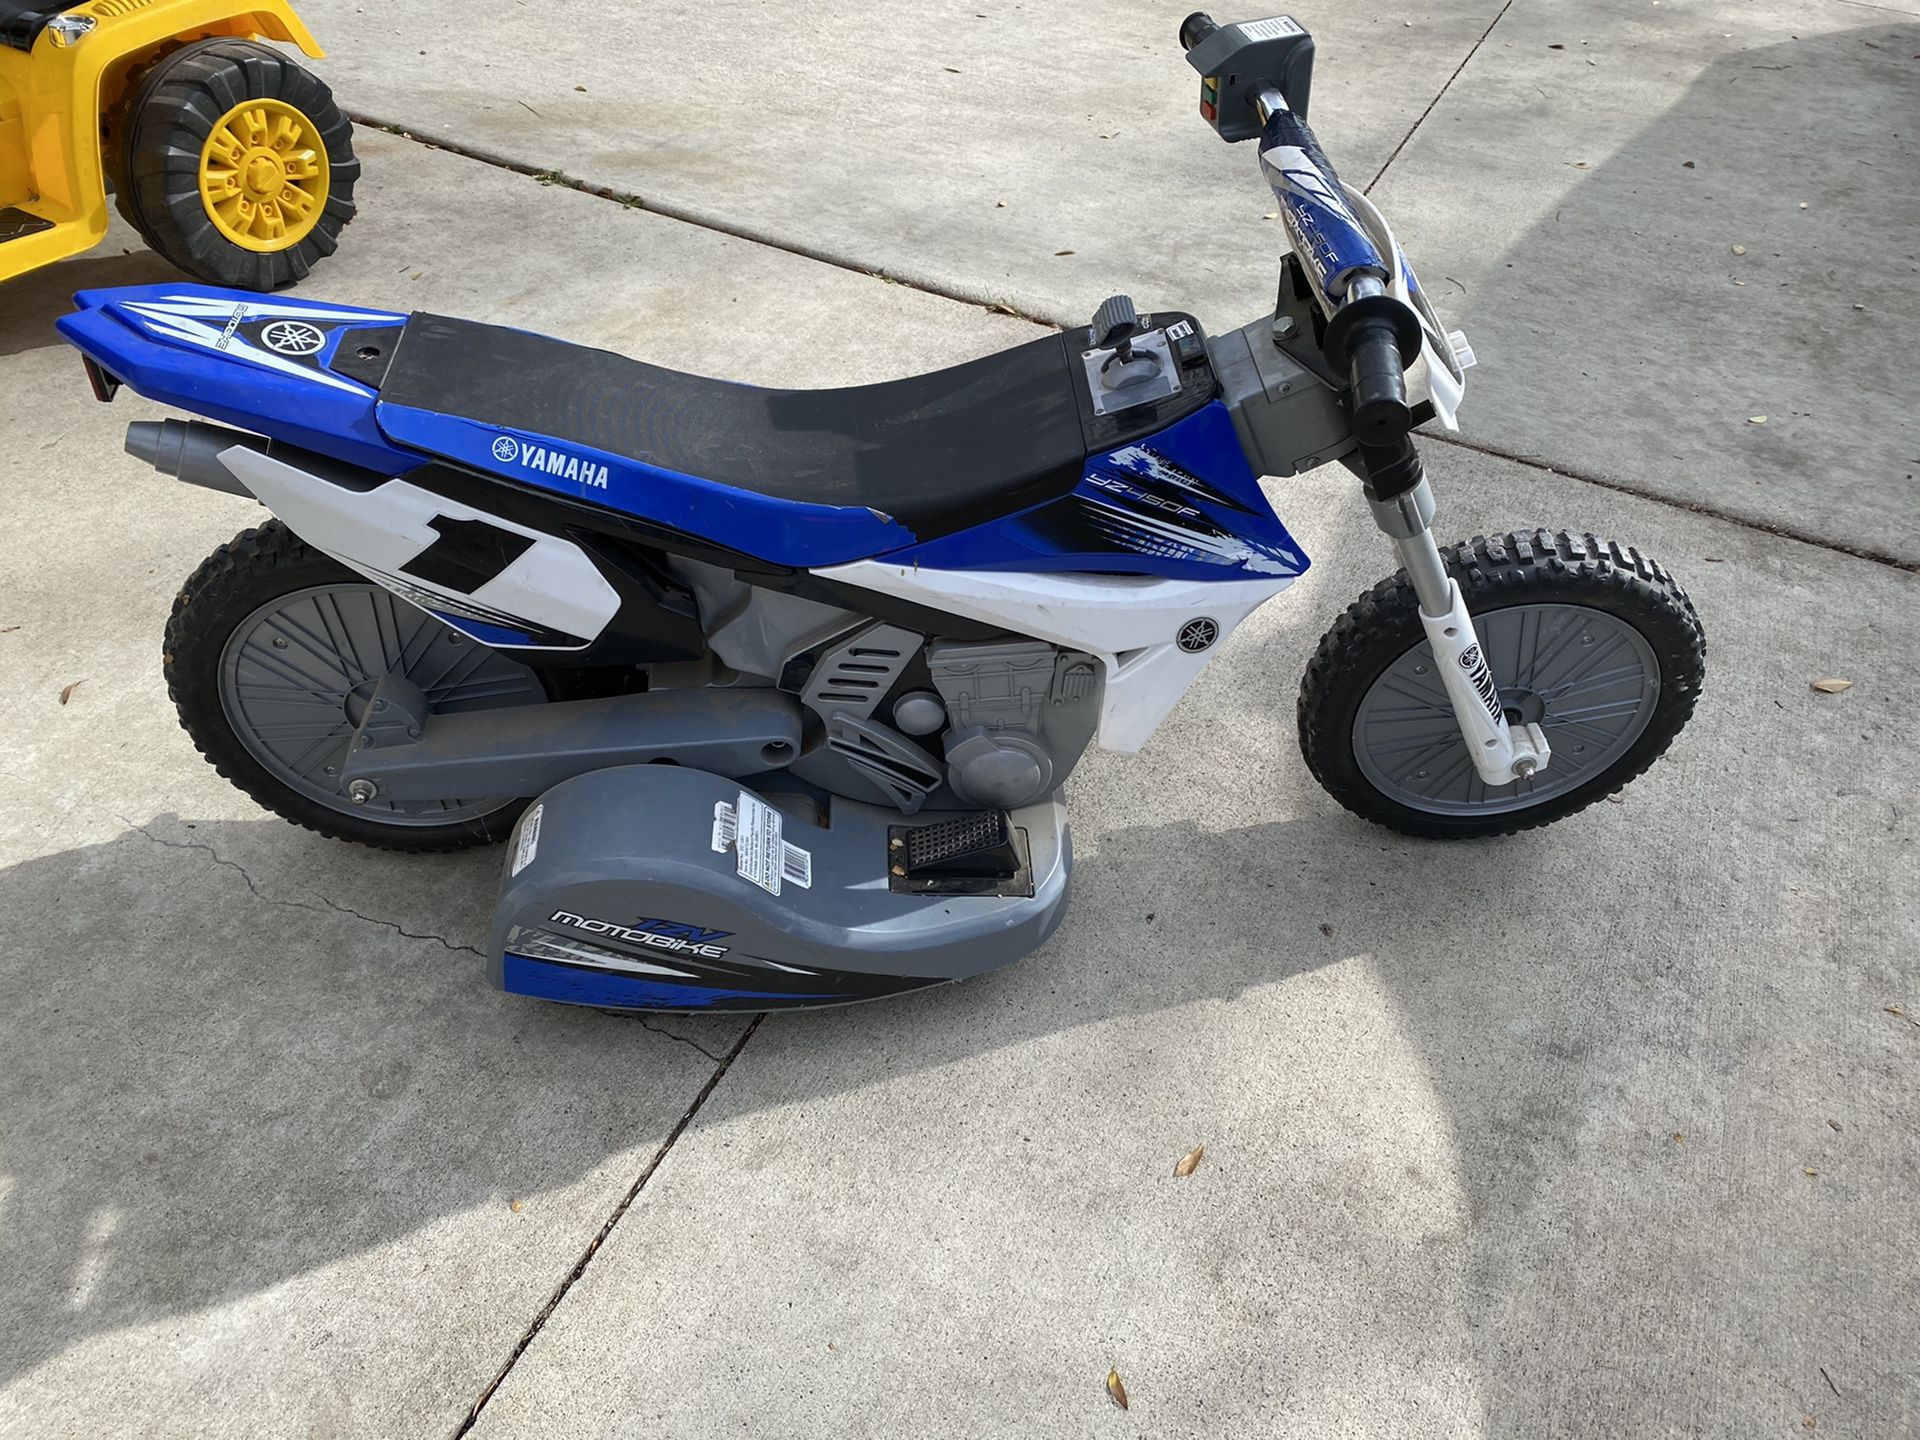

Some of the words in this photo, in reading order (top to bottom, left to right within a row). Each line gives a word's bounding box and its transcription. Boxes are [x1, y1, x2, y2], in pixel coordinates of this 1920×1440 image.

[521, 443, 609, 490] YAMAHA
[1084, 473, 1201, 517] YZ450F
[398, 513, 537, 595] 1
[1470, 656, 1503, 726] YAMAHA
